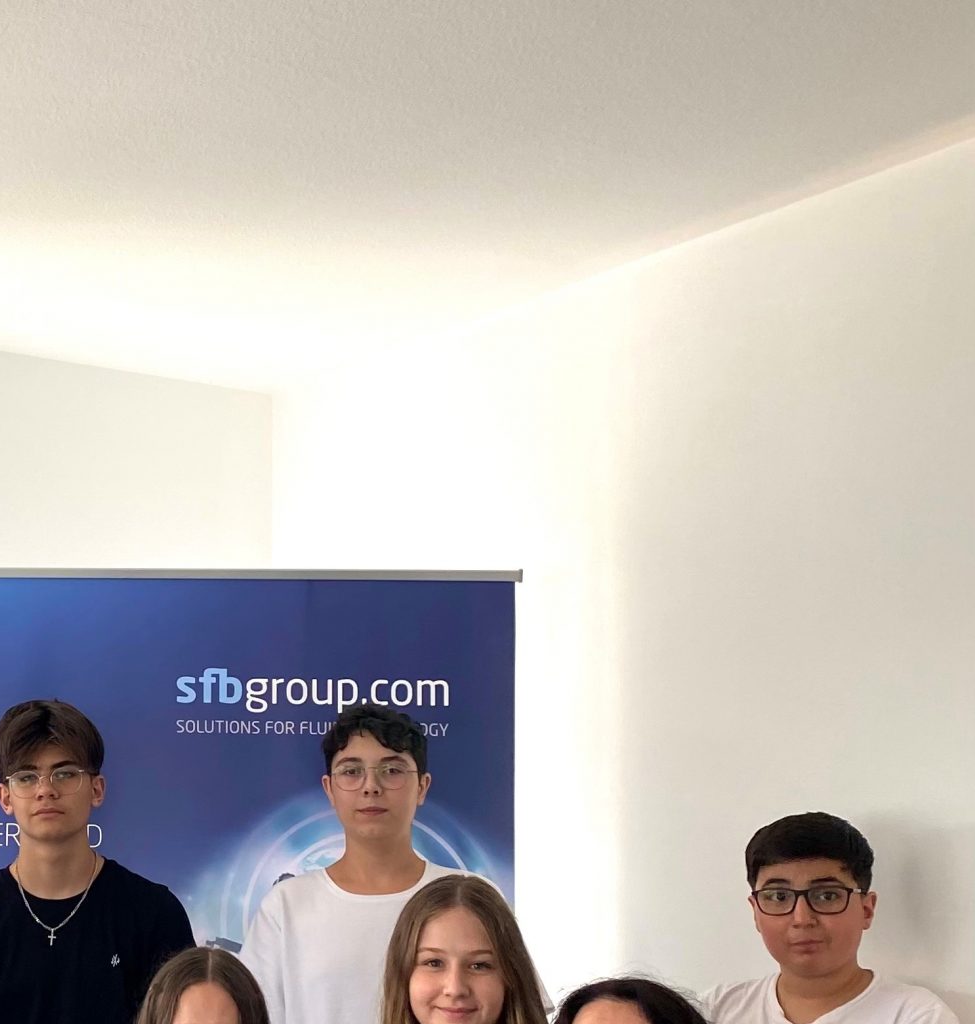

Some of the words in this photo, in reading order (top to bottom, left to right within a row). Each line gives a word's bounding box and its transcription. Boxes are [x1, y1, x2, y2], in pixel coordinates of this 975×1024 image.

[175, 667, 450, 714] sfbgroup.com
[175, 719, 261, 735] SOLUTIONS
[264, 720, 296, 736] FOR
[299, 721, 337, 736] FLUI
